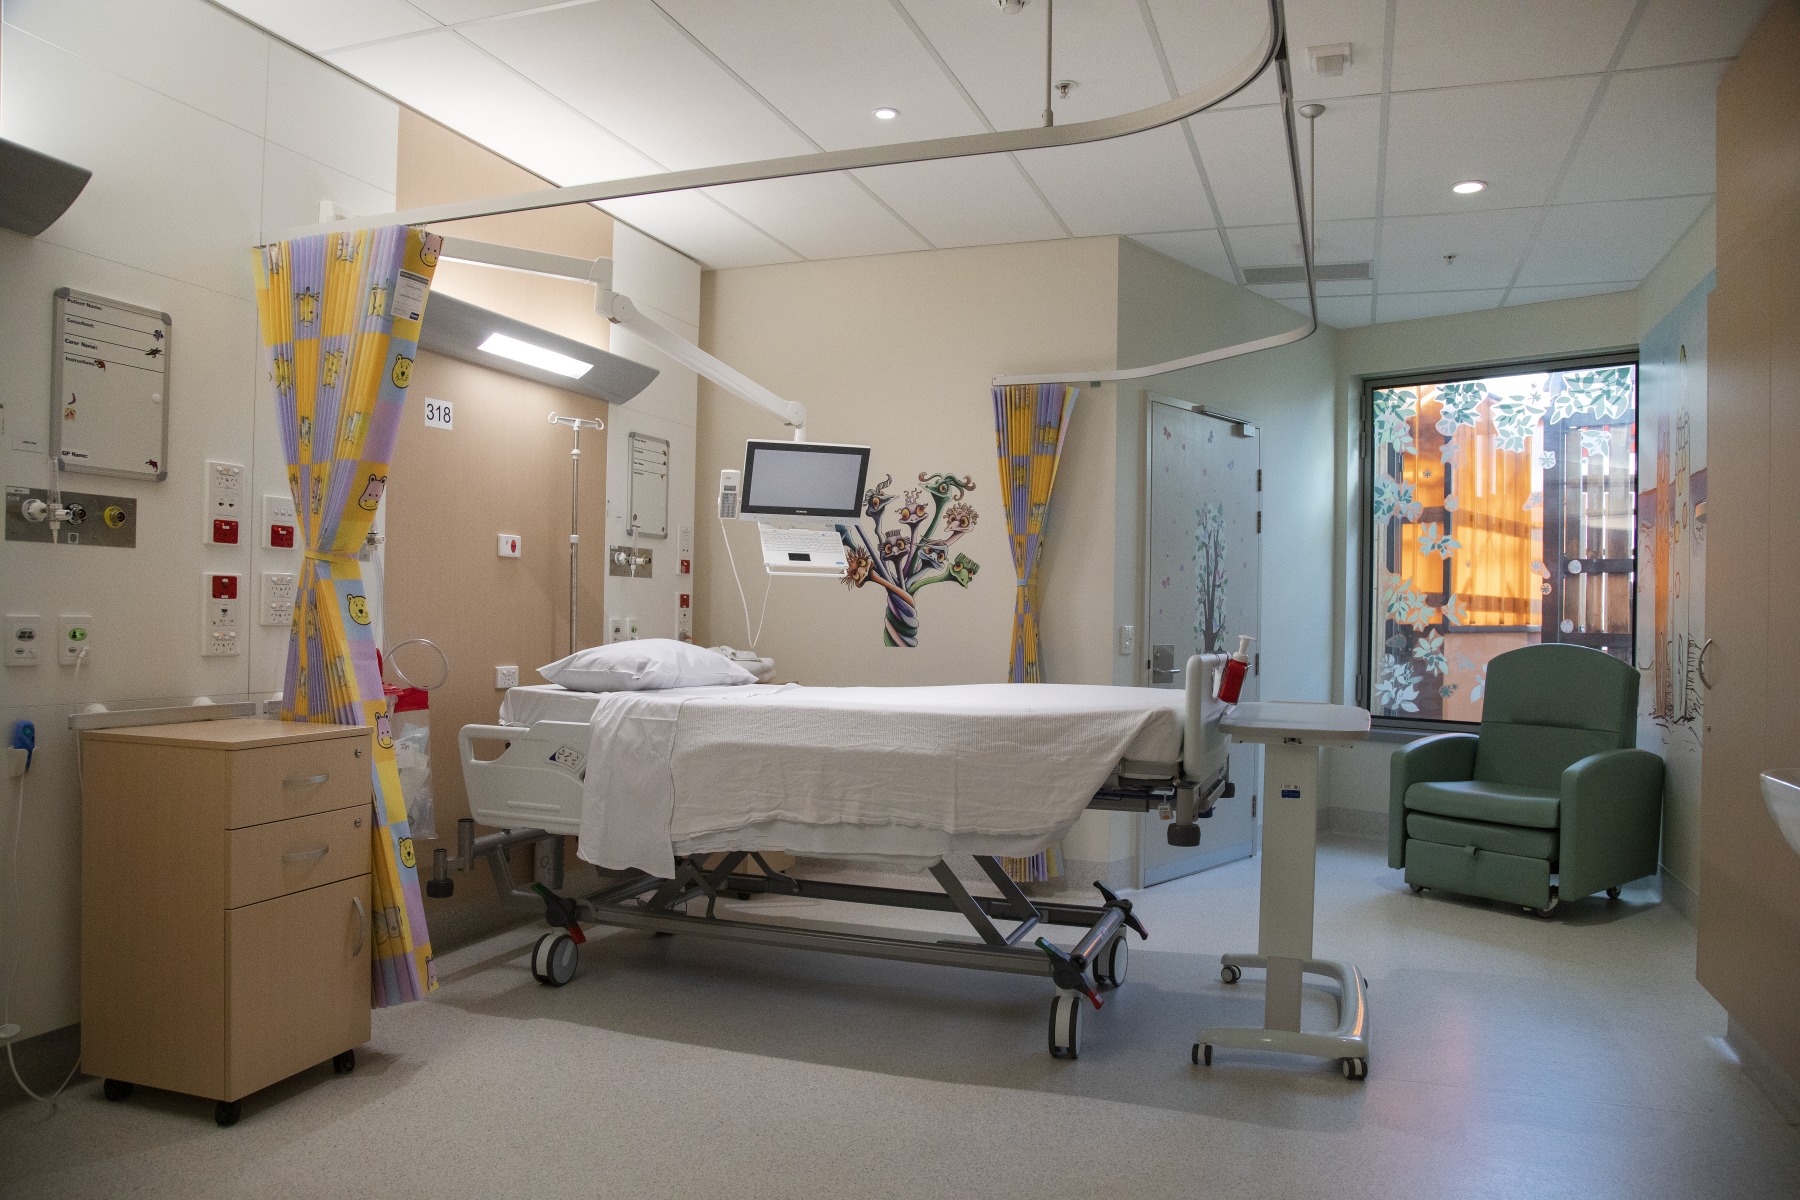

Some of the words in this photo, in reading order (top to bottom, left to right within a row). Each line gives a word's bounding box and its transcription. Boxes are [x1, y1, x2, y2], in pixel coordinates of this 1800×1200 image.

[67, 298, 85, 307] Patient
[86, 302, 102, 310] Name:
[81, 342, 97, 350] Name:
[426, 403, 451, 423] 318
